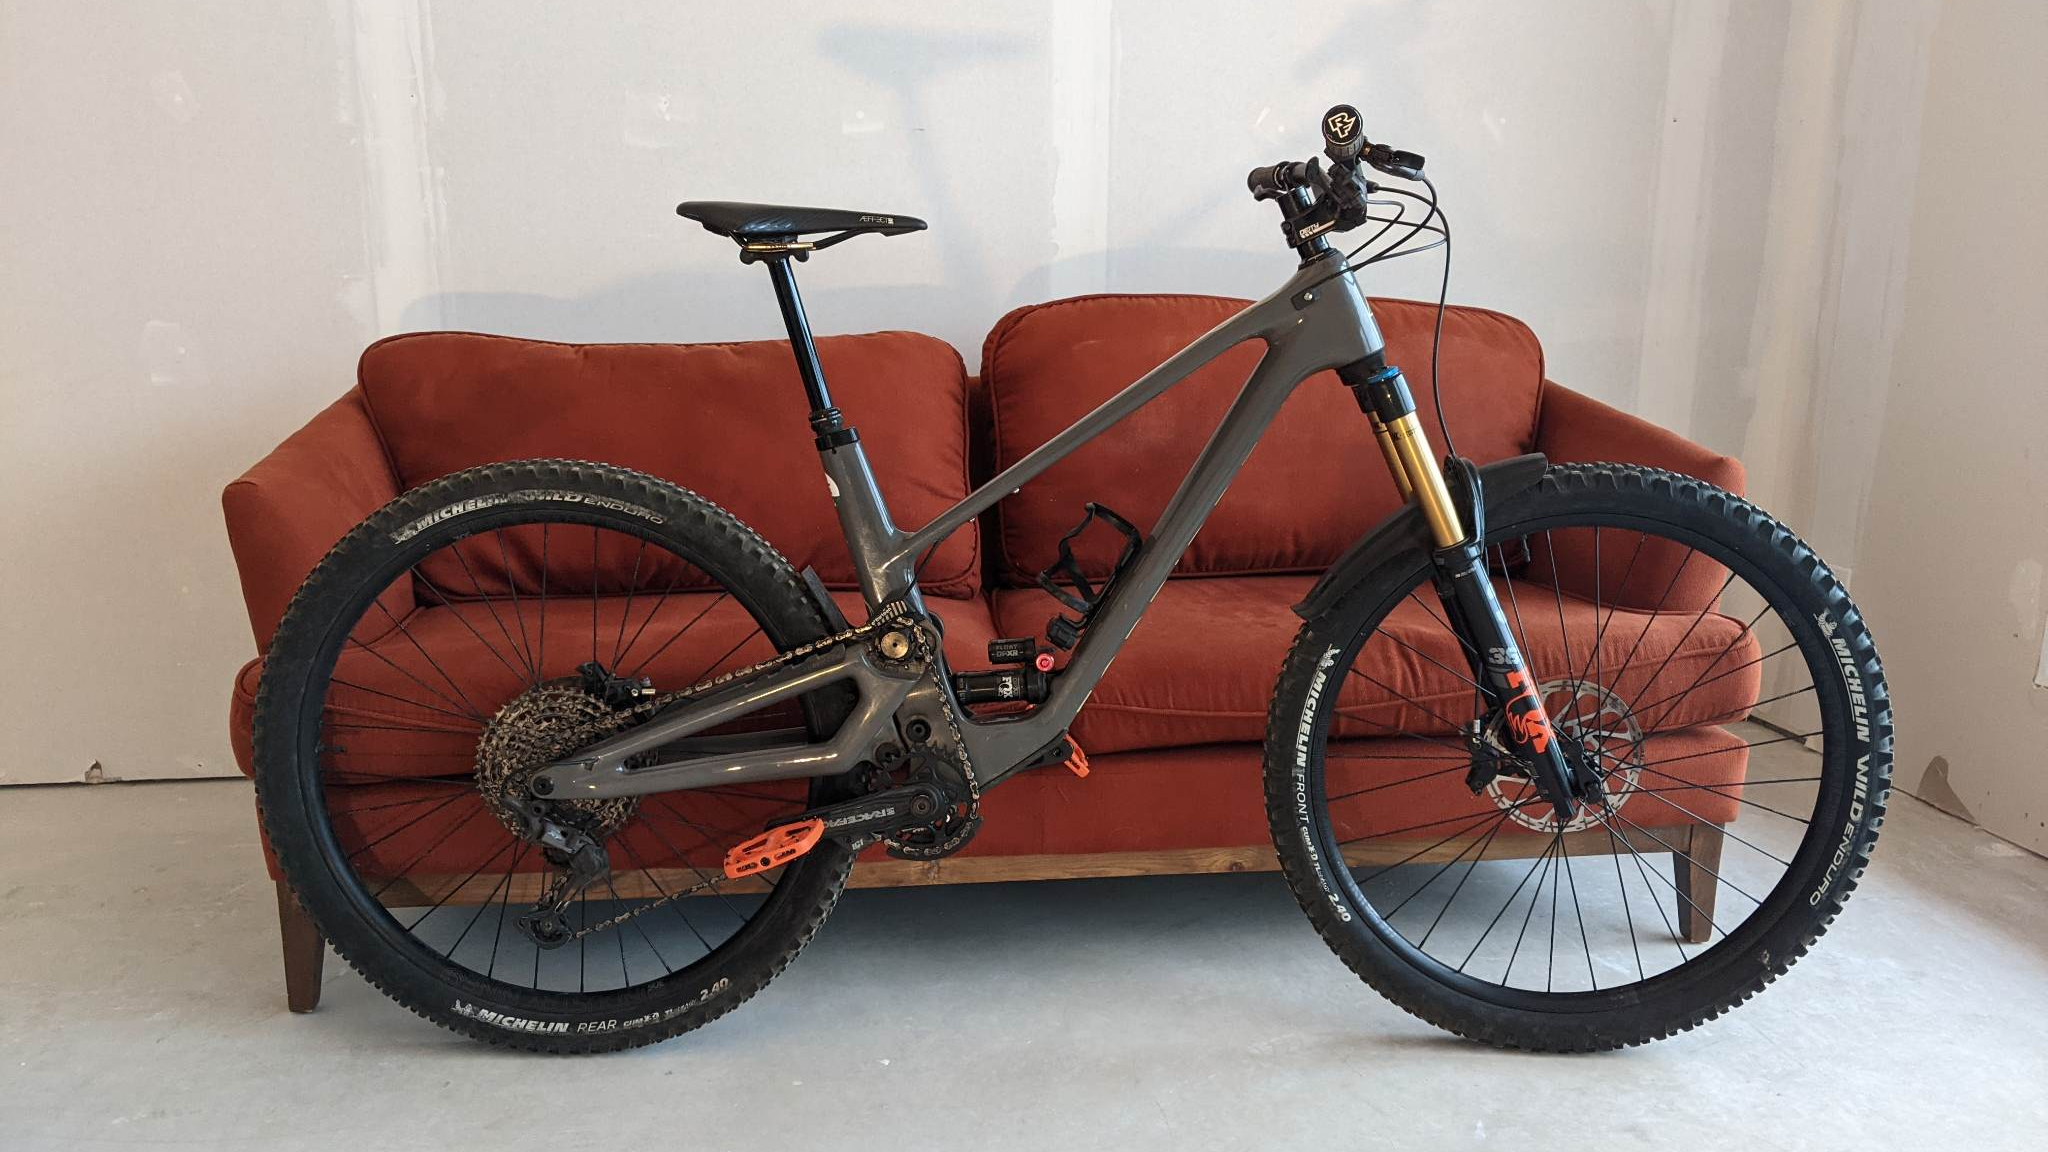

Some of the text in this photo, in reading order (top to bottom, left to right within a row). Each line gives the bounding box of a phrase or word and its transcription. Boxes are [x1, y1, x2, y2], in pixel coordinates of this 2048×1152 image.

[998, 676, 1014, 699] FOX
[1296, 671, 1327, 768] MICHELIN
[1809, 637, 1870, 906] MICHELIN WILD ENDURO
[824, 808, 887, 829] RACEFAC
[1296, 773, 1310, 824] FRONT
[1328, 893, 1352, 922] 2.40
[479, 1008, 570, 1034] MICHELIN
[577, 1019, 617, 1034] REAR
[700, 977, 729, 1001] 2.40
